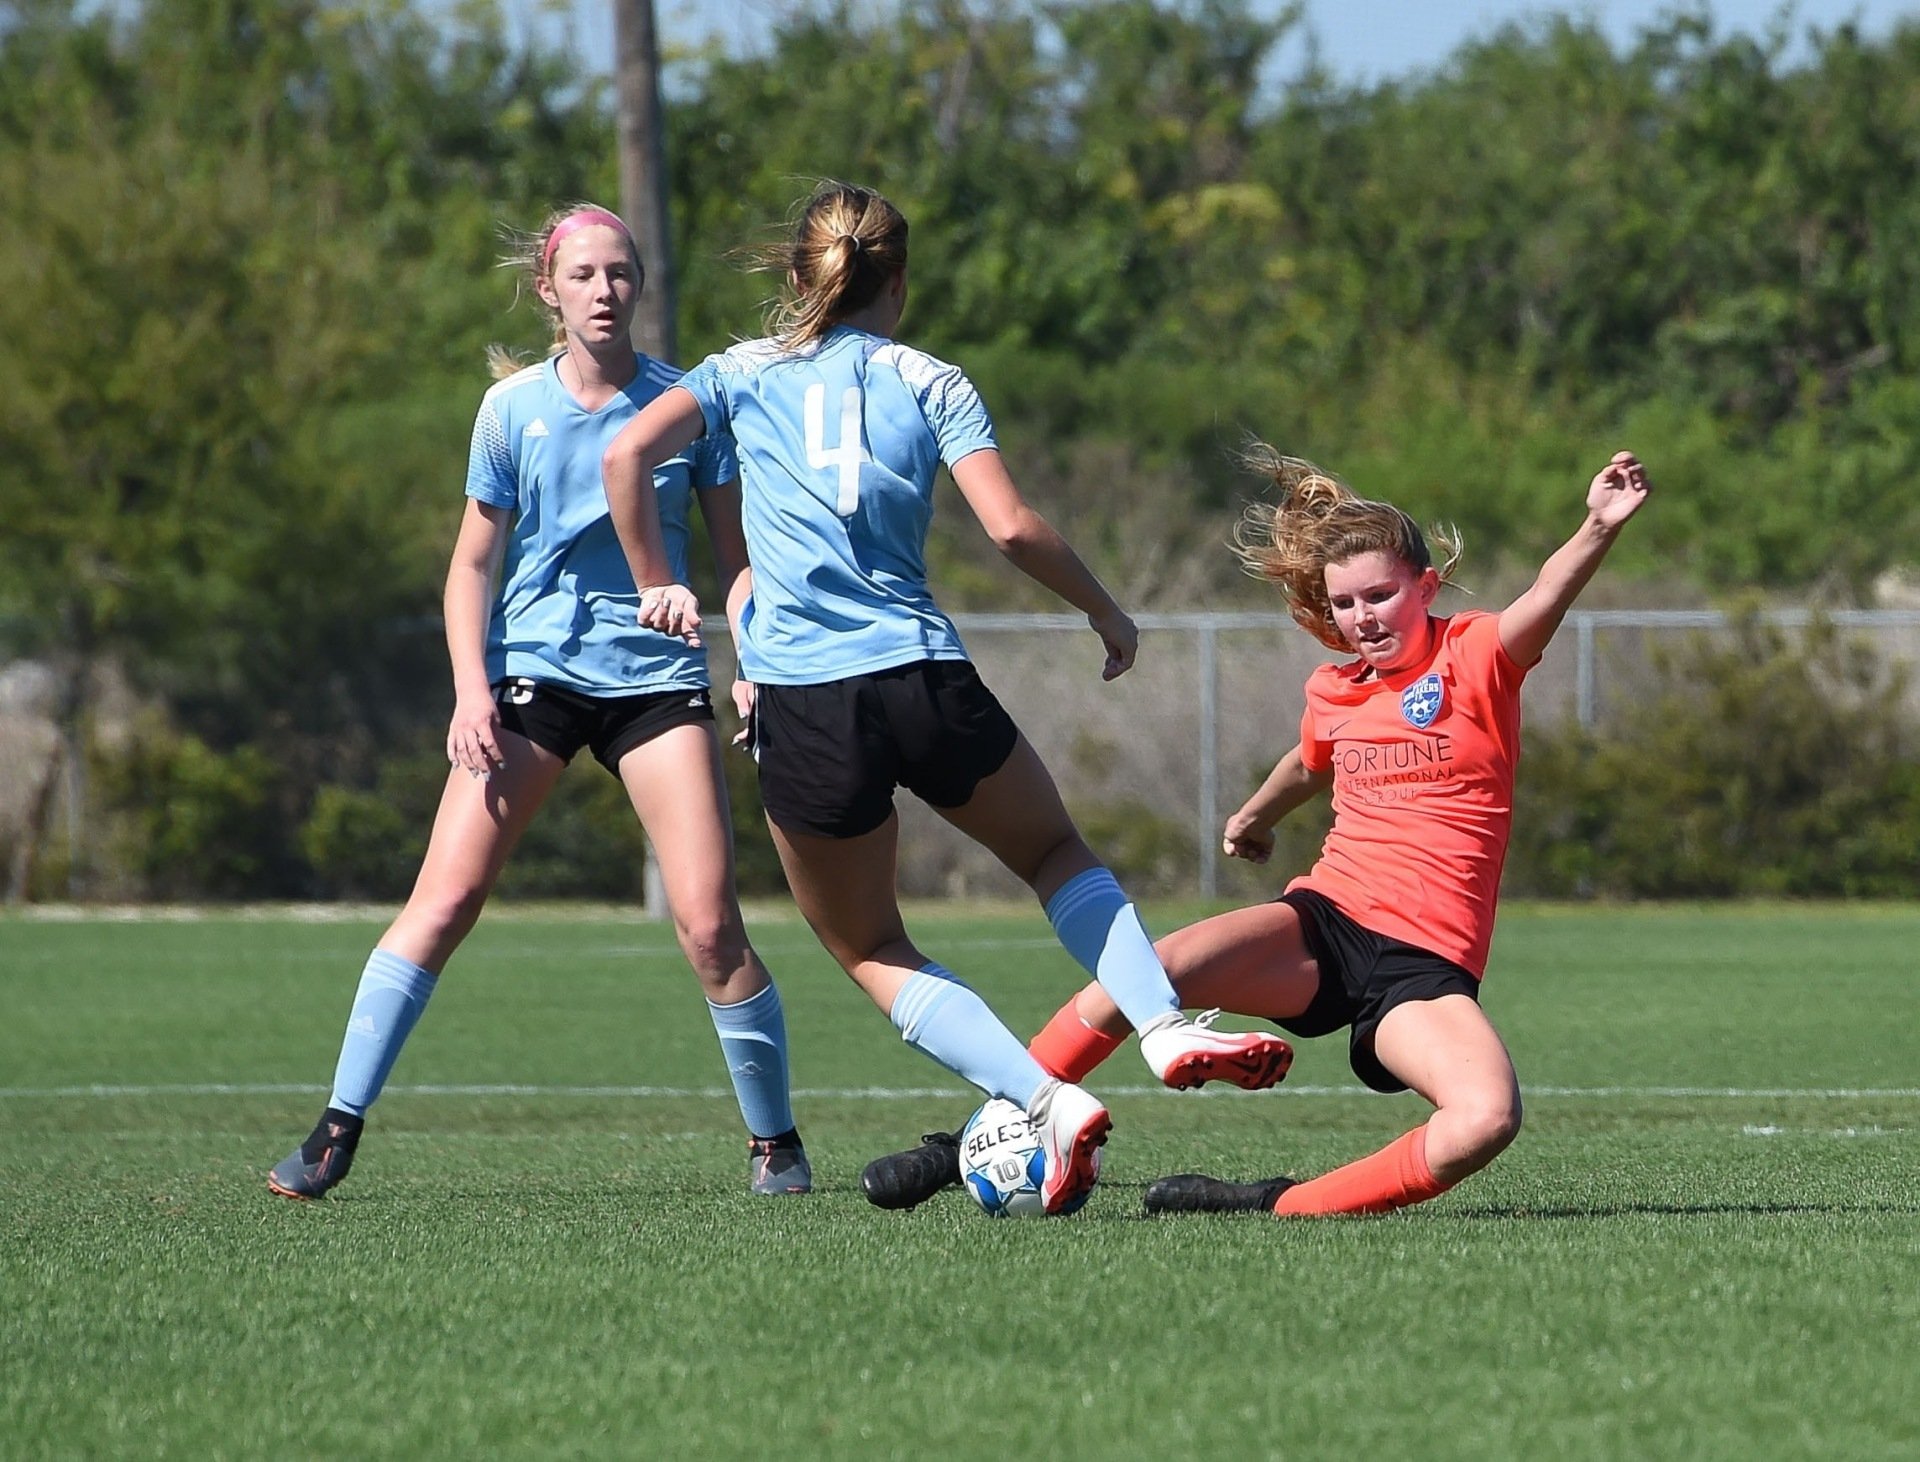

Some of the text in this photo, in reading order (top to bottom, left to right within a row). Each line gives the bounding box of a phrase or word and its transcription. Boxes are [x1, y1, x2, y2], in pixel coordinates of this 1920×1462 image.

[804, 383, 872, 517] 4
[1335, 737, 1453, 774] FORTUNE
[1339, 767, 1456, 791] TERNATIONAL
[968, 1119, 1037, 1158] SELECT
[993, 1159, 1021, 1184] 10
